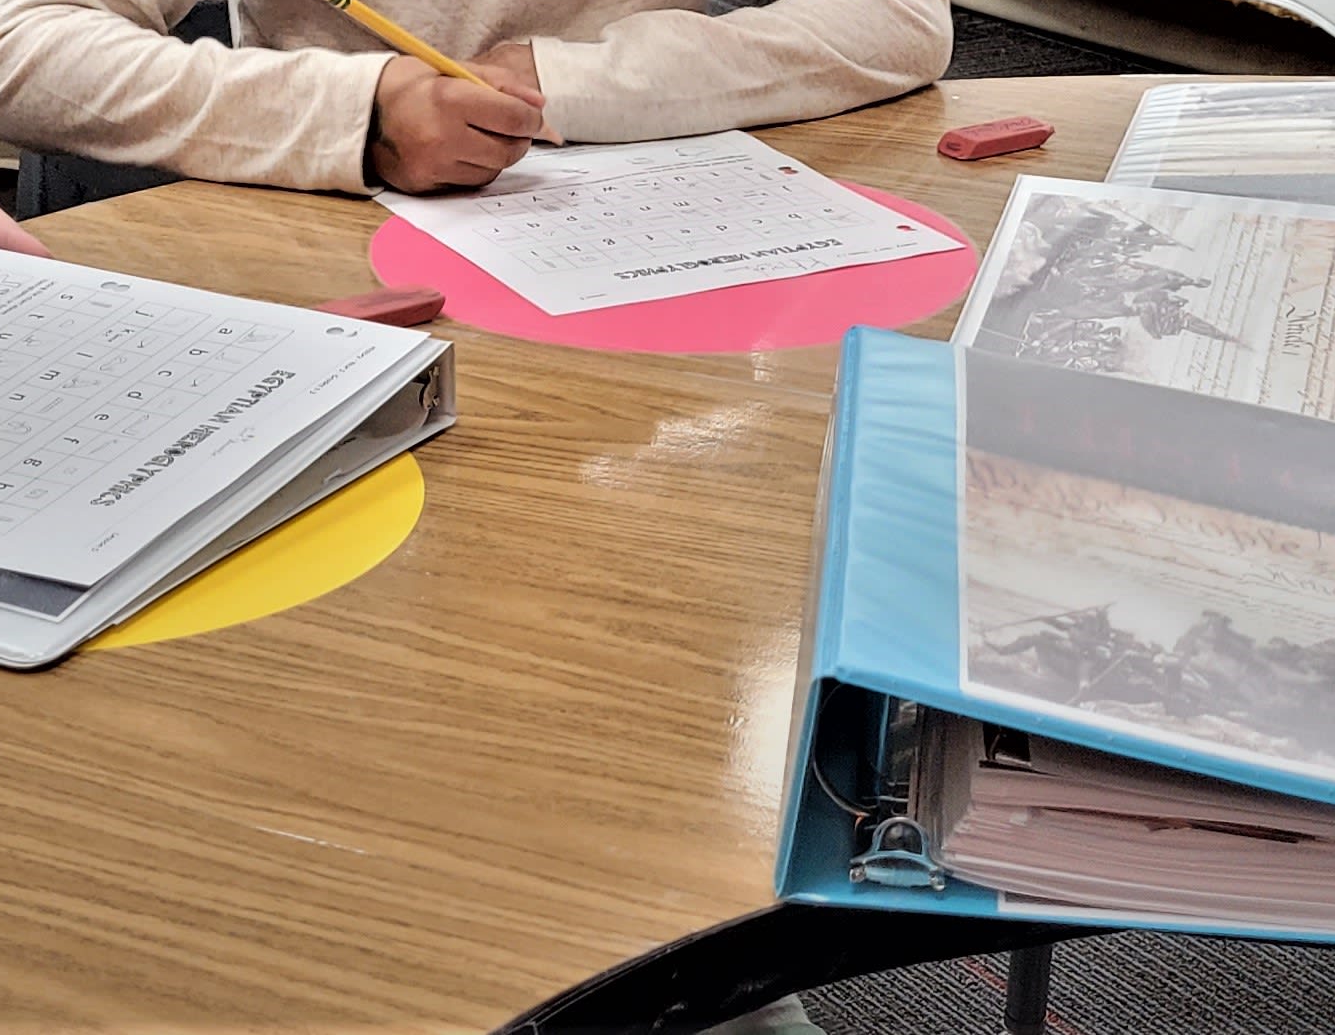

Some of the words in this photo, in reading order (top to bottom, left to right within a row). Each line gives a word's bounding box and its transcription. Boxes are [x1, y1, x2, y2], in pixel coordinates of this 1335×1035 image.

[750, 238, 844, 258] EGYPTIAN
[60, 293, 74, 301] s
[135, 309, 154, 318] j
[218, 327, 233, 335] a
[188, 348, 209, 356] b
[39, 369, 61, 381] m
[9, 393, 26, 401] n
[127, 391, 143, 400] d
[207, 370, 296, 424] EGYPTIAN
[94, 413, 110, 421] e
[63, 437, 80, 445] f
[23, 458, 43, 468] g
